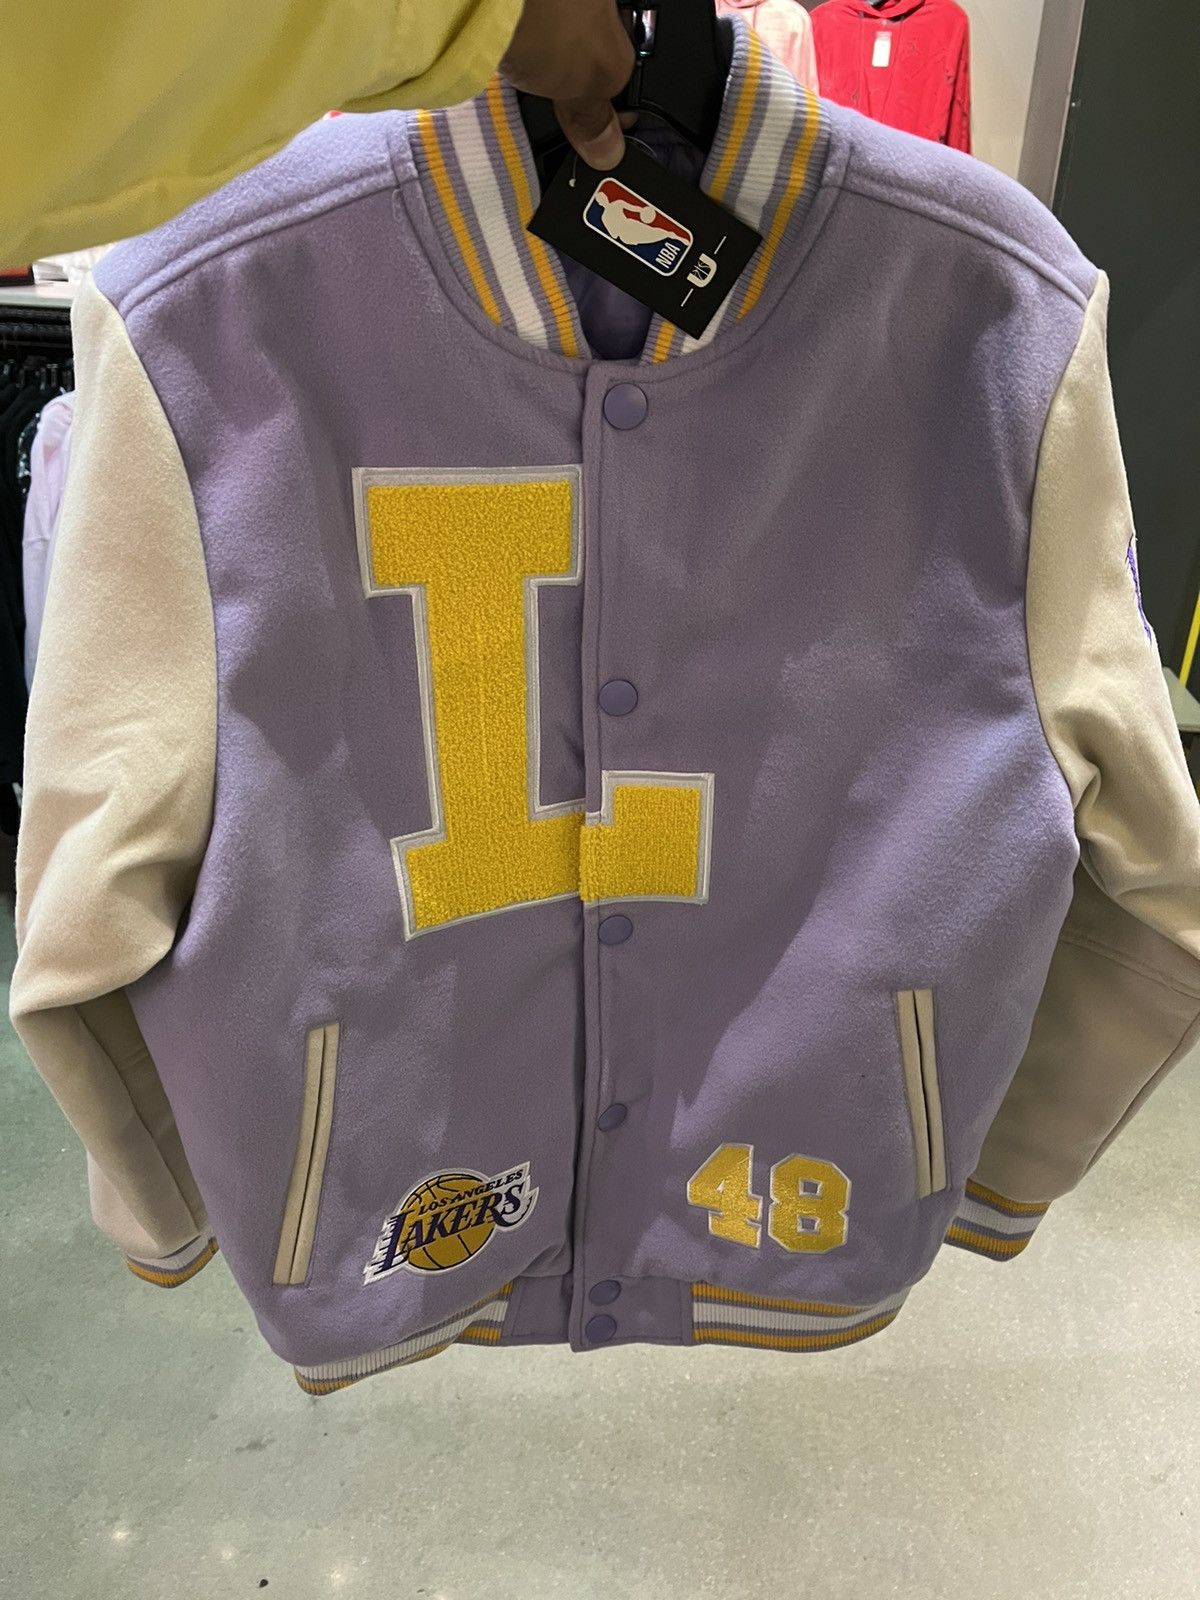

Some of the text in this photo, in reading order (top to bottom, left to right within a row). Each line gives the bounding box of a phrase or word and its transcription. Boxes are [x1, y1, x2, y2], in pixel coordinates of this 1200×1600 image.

[655, 242, 681, 269] NBA
[352, 464, 714, 941] L
[371, 1181, 532, 1275] LAKERS
[418, 1169, 524, 1215] LOS ANGELES
[687, 1142, 852, 1254] 48
